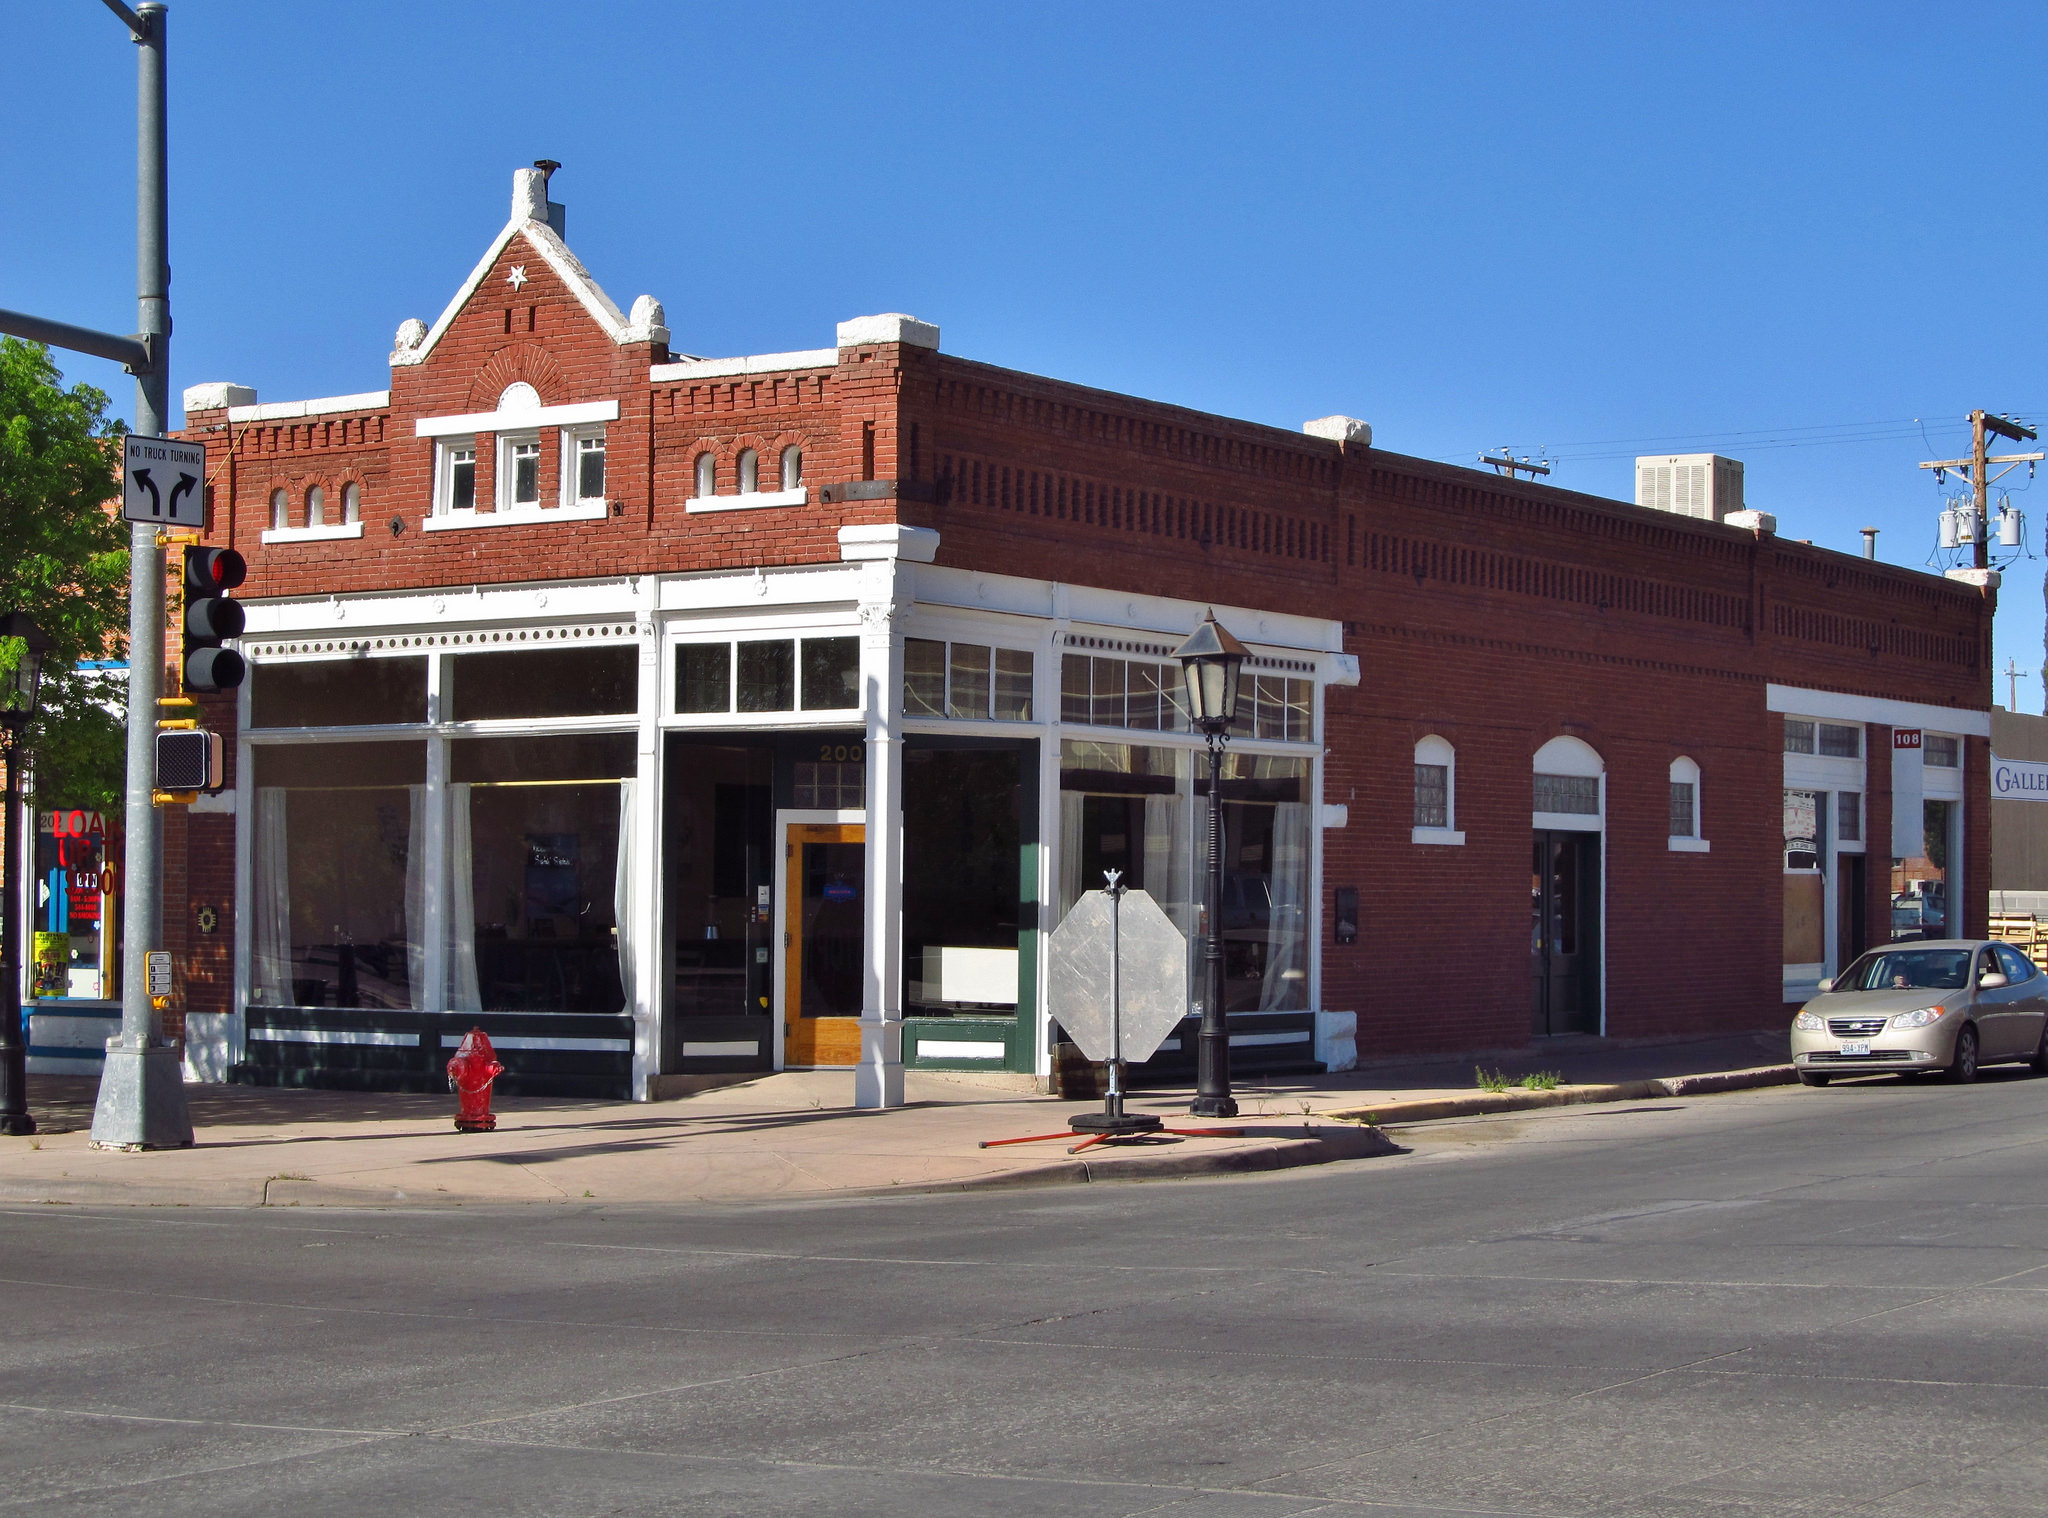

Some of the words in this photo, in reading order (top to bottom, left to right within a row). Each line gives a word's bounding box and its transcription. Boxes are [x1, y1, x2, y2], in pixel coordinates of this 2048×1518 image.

[130, 445, 140, 458] NO
[144, 446, 167, 460] TRUCK
[170, 450, 200, 464] TURNING
[1896, 734, 1919, 745] 108
[820, 745, 863, 761] 200
[1995, 766, 2048, 793] GALLE
